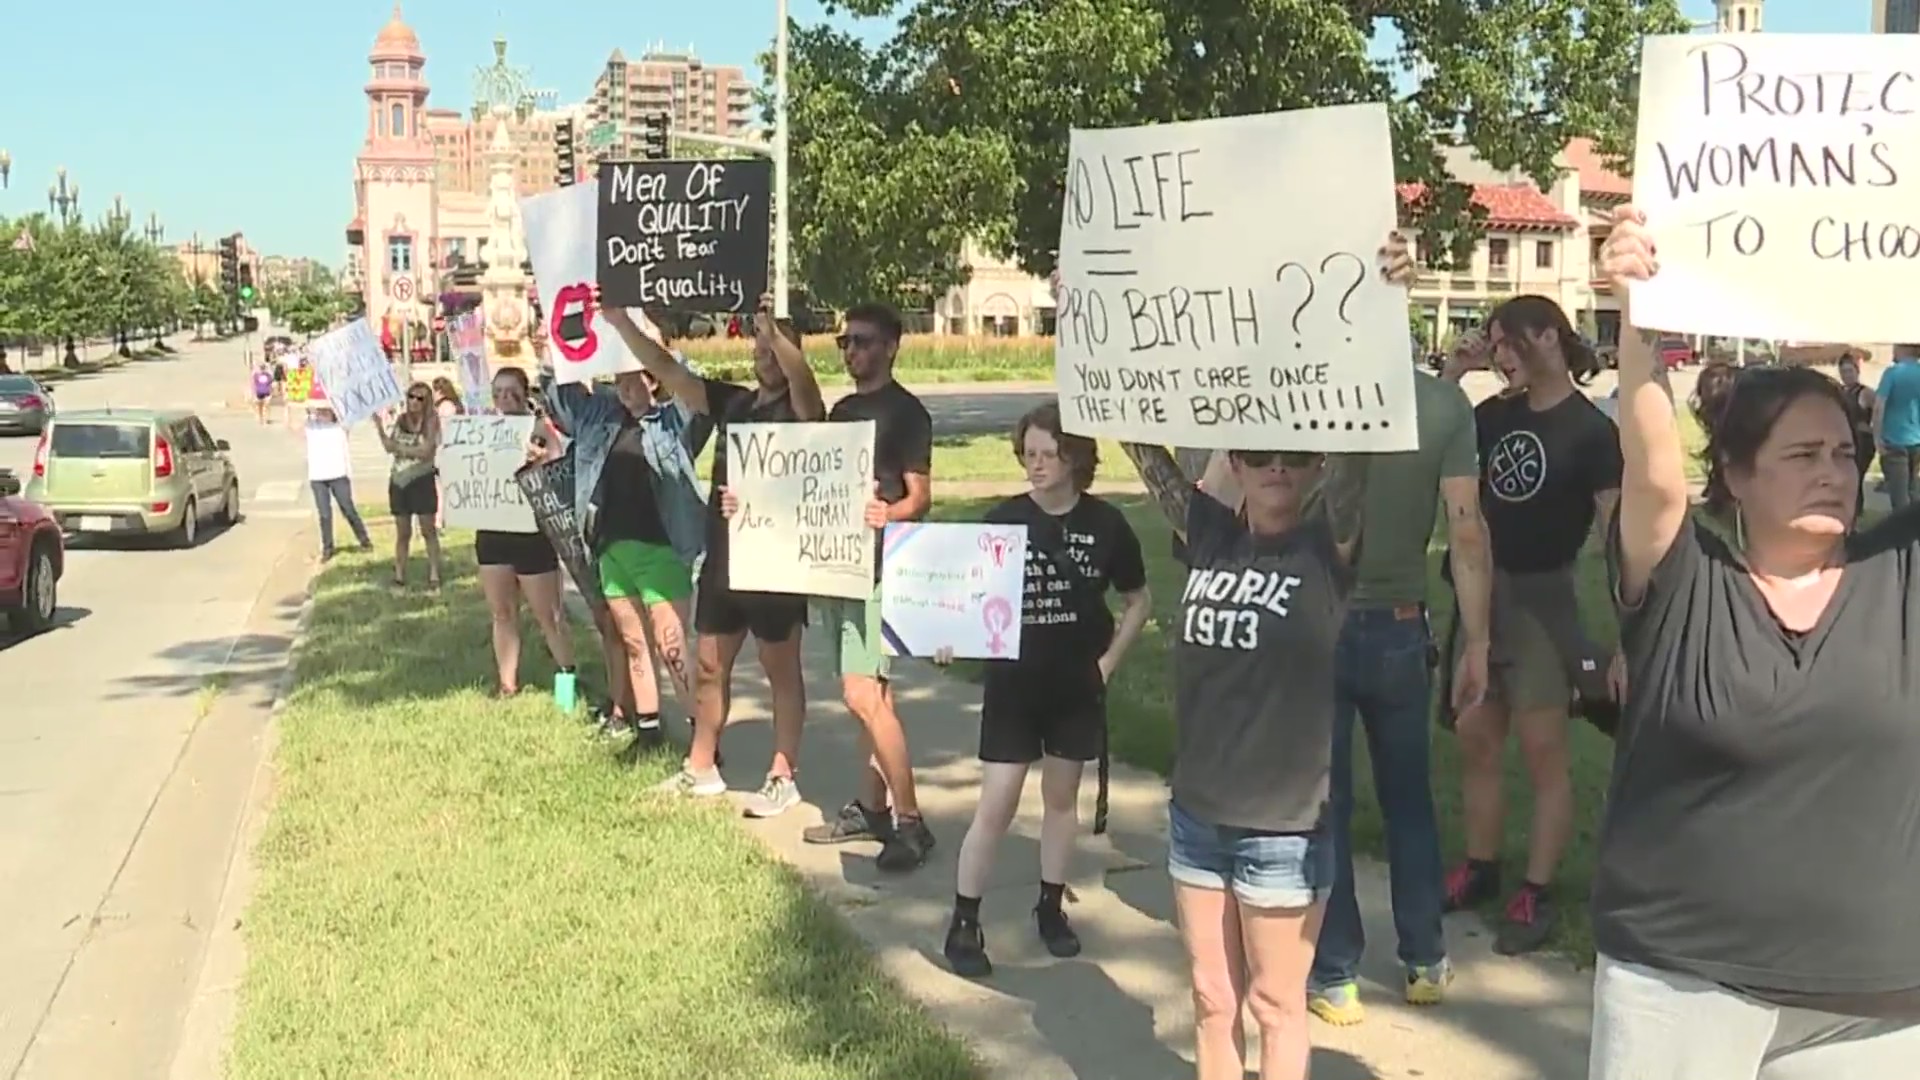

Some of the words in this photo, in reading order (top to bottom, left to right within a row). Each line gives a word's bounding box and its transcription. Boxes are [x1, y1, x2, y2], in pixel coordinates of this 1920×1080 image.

[1656, 122, 1898, 200] WOMAN'S
[610, 164, 666, 204] Men
[685, 162, 726, 201] Of
[1101, 148, 1214, 230] LIFE
[637, 193, 750, 236] QUALITY
[1686, 210, 1765, 259] TO
[1810, 215, 1920, 262] CHOO
[607, 236, 666, 266] Don't
[676, 233, 719, 259] Fear
[639, 262, 745, 310] Equality
[1058, 284, 1109, 356] PRO
[1121, 286, 1260, 352] BIRTH
[1074, 363, 1111, 392] YOU
[1119, 367, 1181, 392] DON'T
[1194, 365, 1252, 389] CARE
[1269, 362, 1330, 387] ONCE
[1071, 393, 1168, 424] THEY'RE
[461, 448, 488, 476] TO
[730, 431, 843, 478] Woman's
[737, 501, 774, 532] Are
[795, 503, 850, 528] HUMAN
[798, 533, 862, 564] RIGHTS
[1184, 604, 1259, 649] 1973
